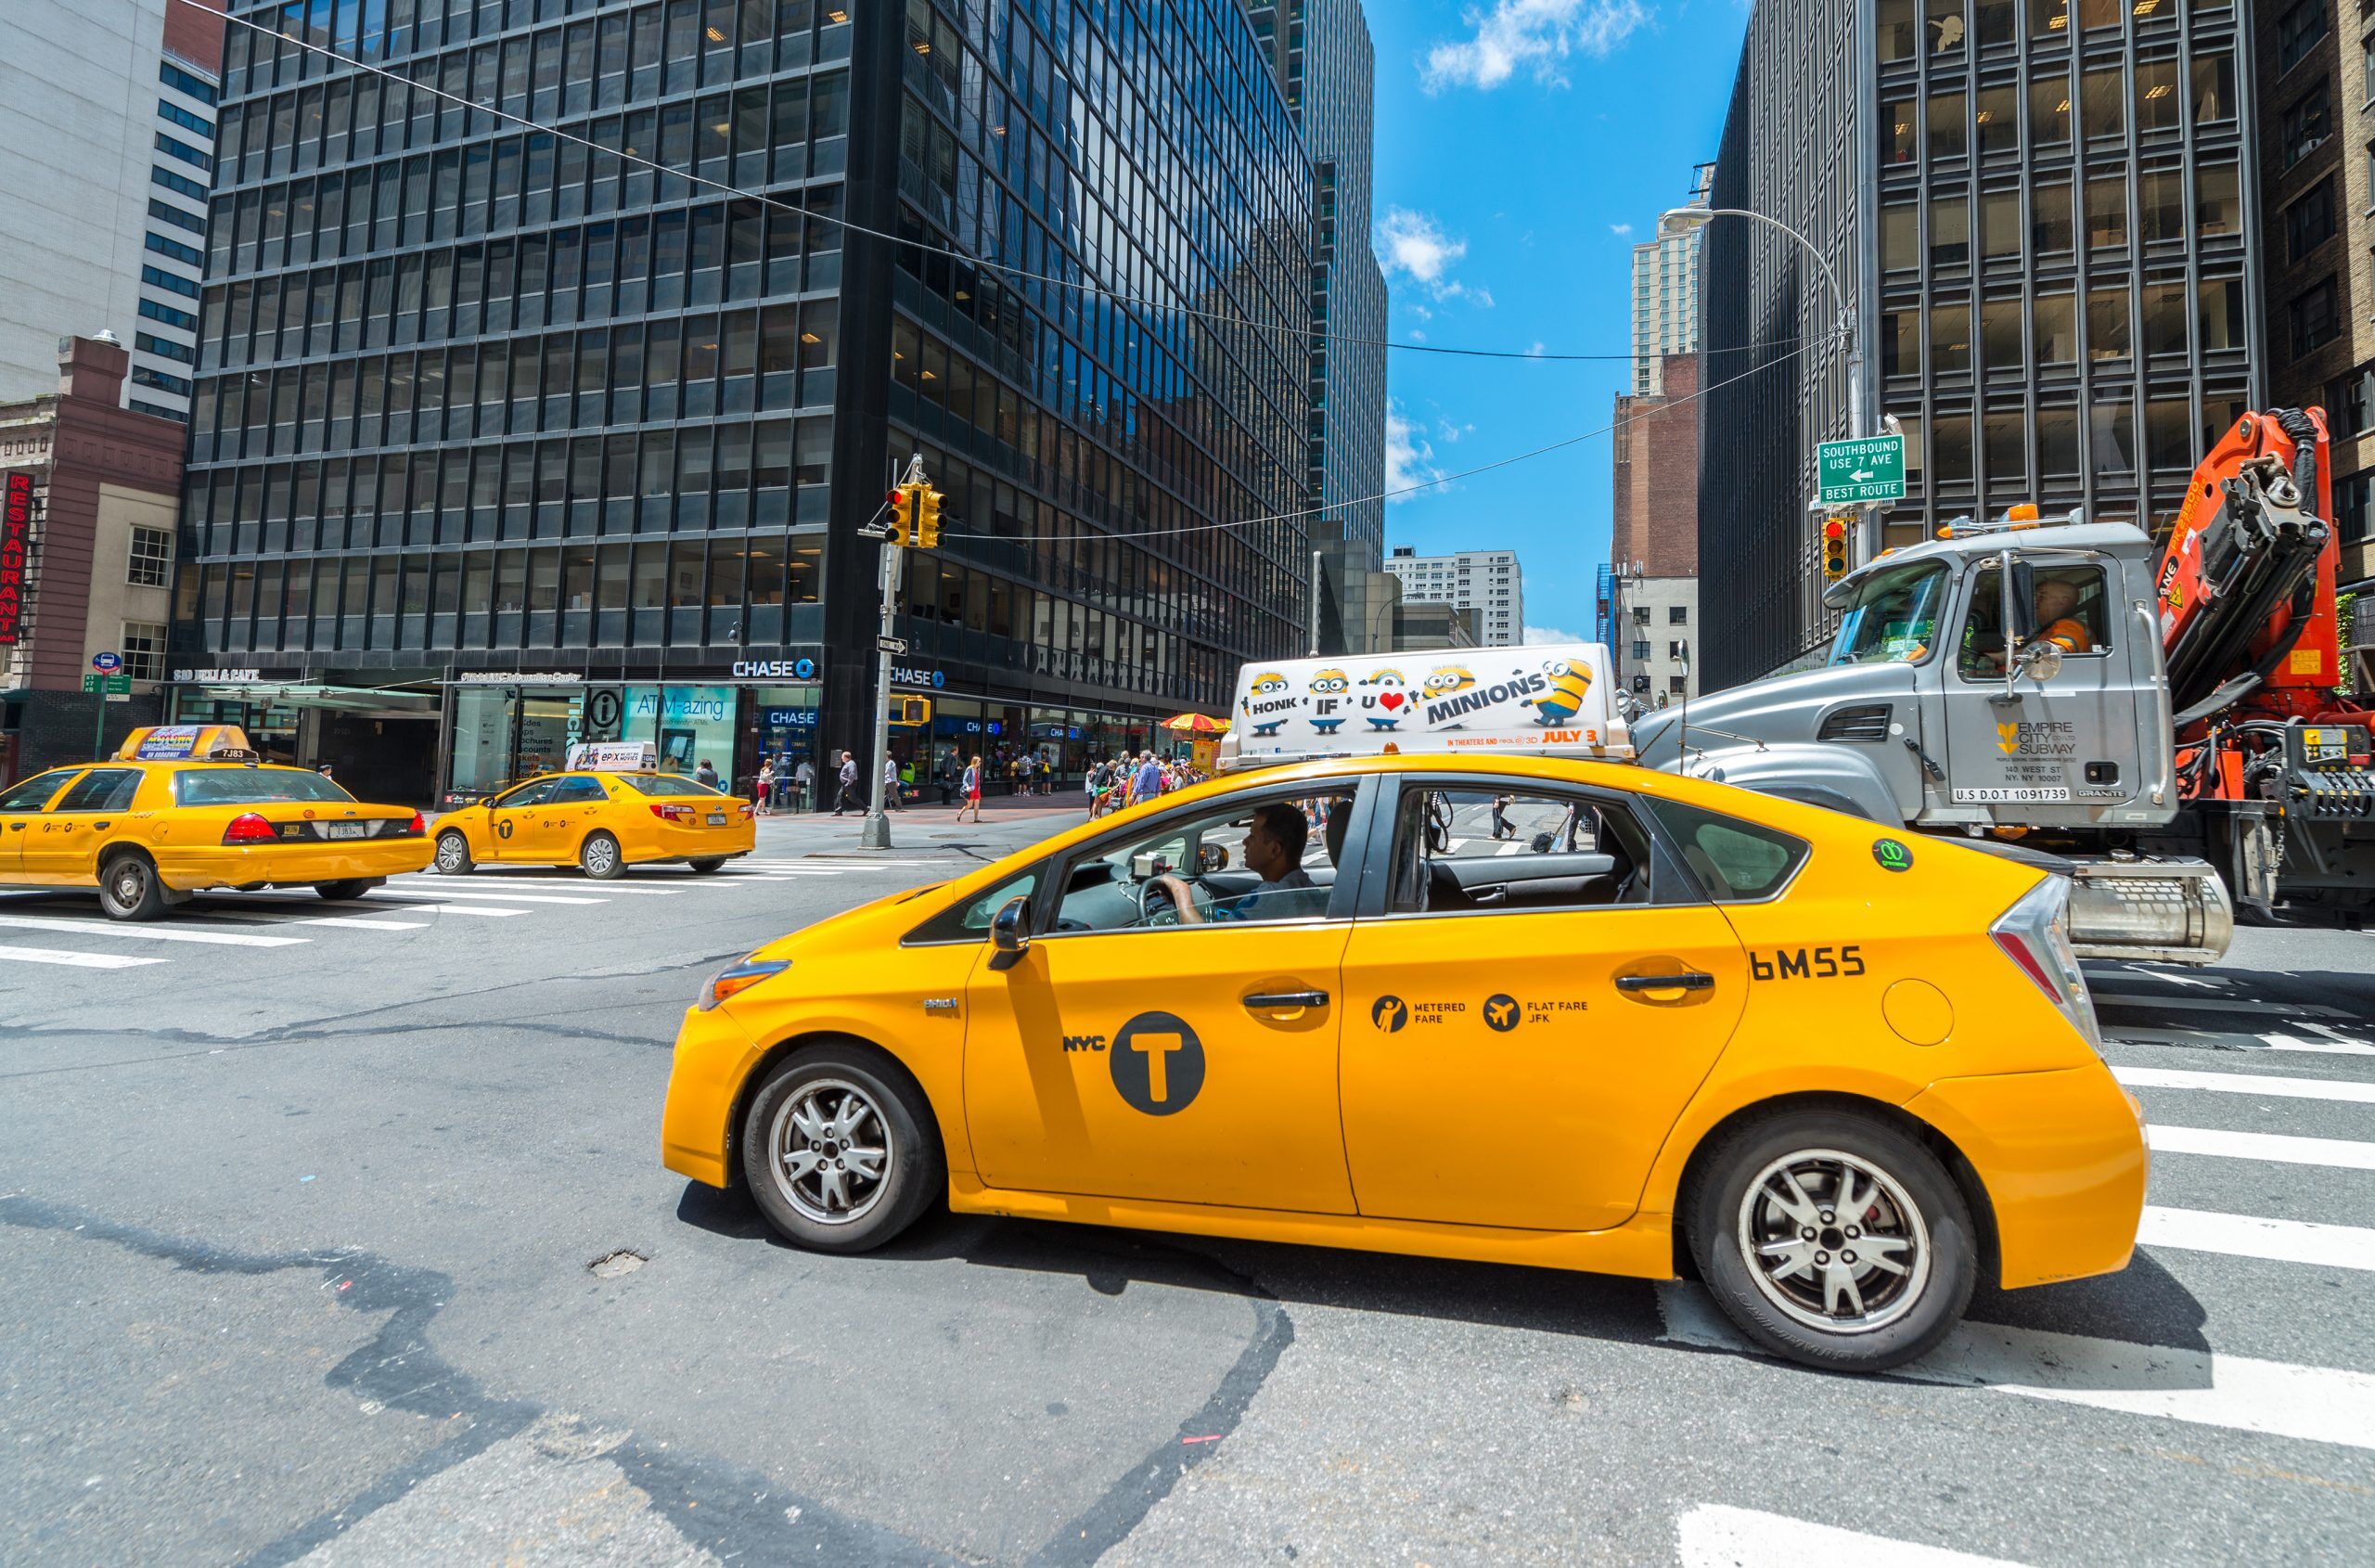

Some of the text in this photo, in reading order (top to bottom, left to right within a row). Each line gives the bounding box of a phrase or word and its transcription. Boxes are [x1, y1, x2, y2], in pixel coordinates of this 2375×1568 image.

[1824, 441, 1898, 457] SOUTHBOUND
[1829, 454, 1892, 469] USE 7 AVE
[1826, 483, 1897, 500] BEST ROUTE
[0, 475, 30, 632] RESTAURANT
[733, 661, 794, 676] CHASE
[890, 666, 931, 686] CHASE
[1252, 696, 1376, 715] HONK IF U
[1427, 673, 1546, 725] MINIONS
[637, 694, 724, 721] ATM-azing
[770, 712, 815, 724] CHASE
[967, 722, 994, 733] CHAE
[2018, 722, 2073, 732] EMPIRE
[1542, 729, 1597, 743] JULY 3
[2019, 732, 2051, 743] CITY
[223, 749, 243, 758] 7J83
[2019, 743, 2075, 754] SUBWAY
[1980, 790, 2009, 800] D.O.T
[2014, 789, 2067, 800] 1091739
[1415, 1003, 1465, 1011] METERED
[1527, 1001, 1587, 1011] FLAT FARE
[1415, 1015, 1443, 1023] FARE
[1528, 1014, 1550, 1022] JFK
[1063, 1035, 1106, 1052] NYC
[1130, 1032, 1182, 1102] T
